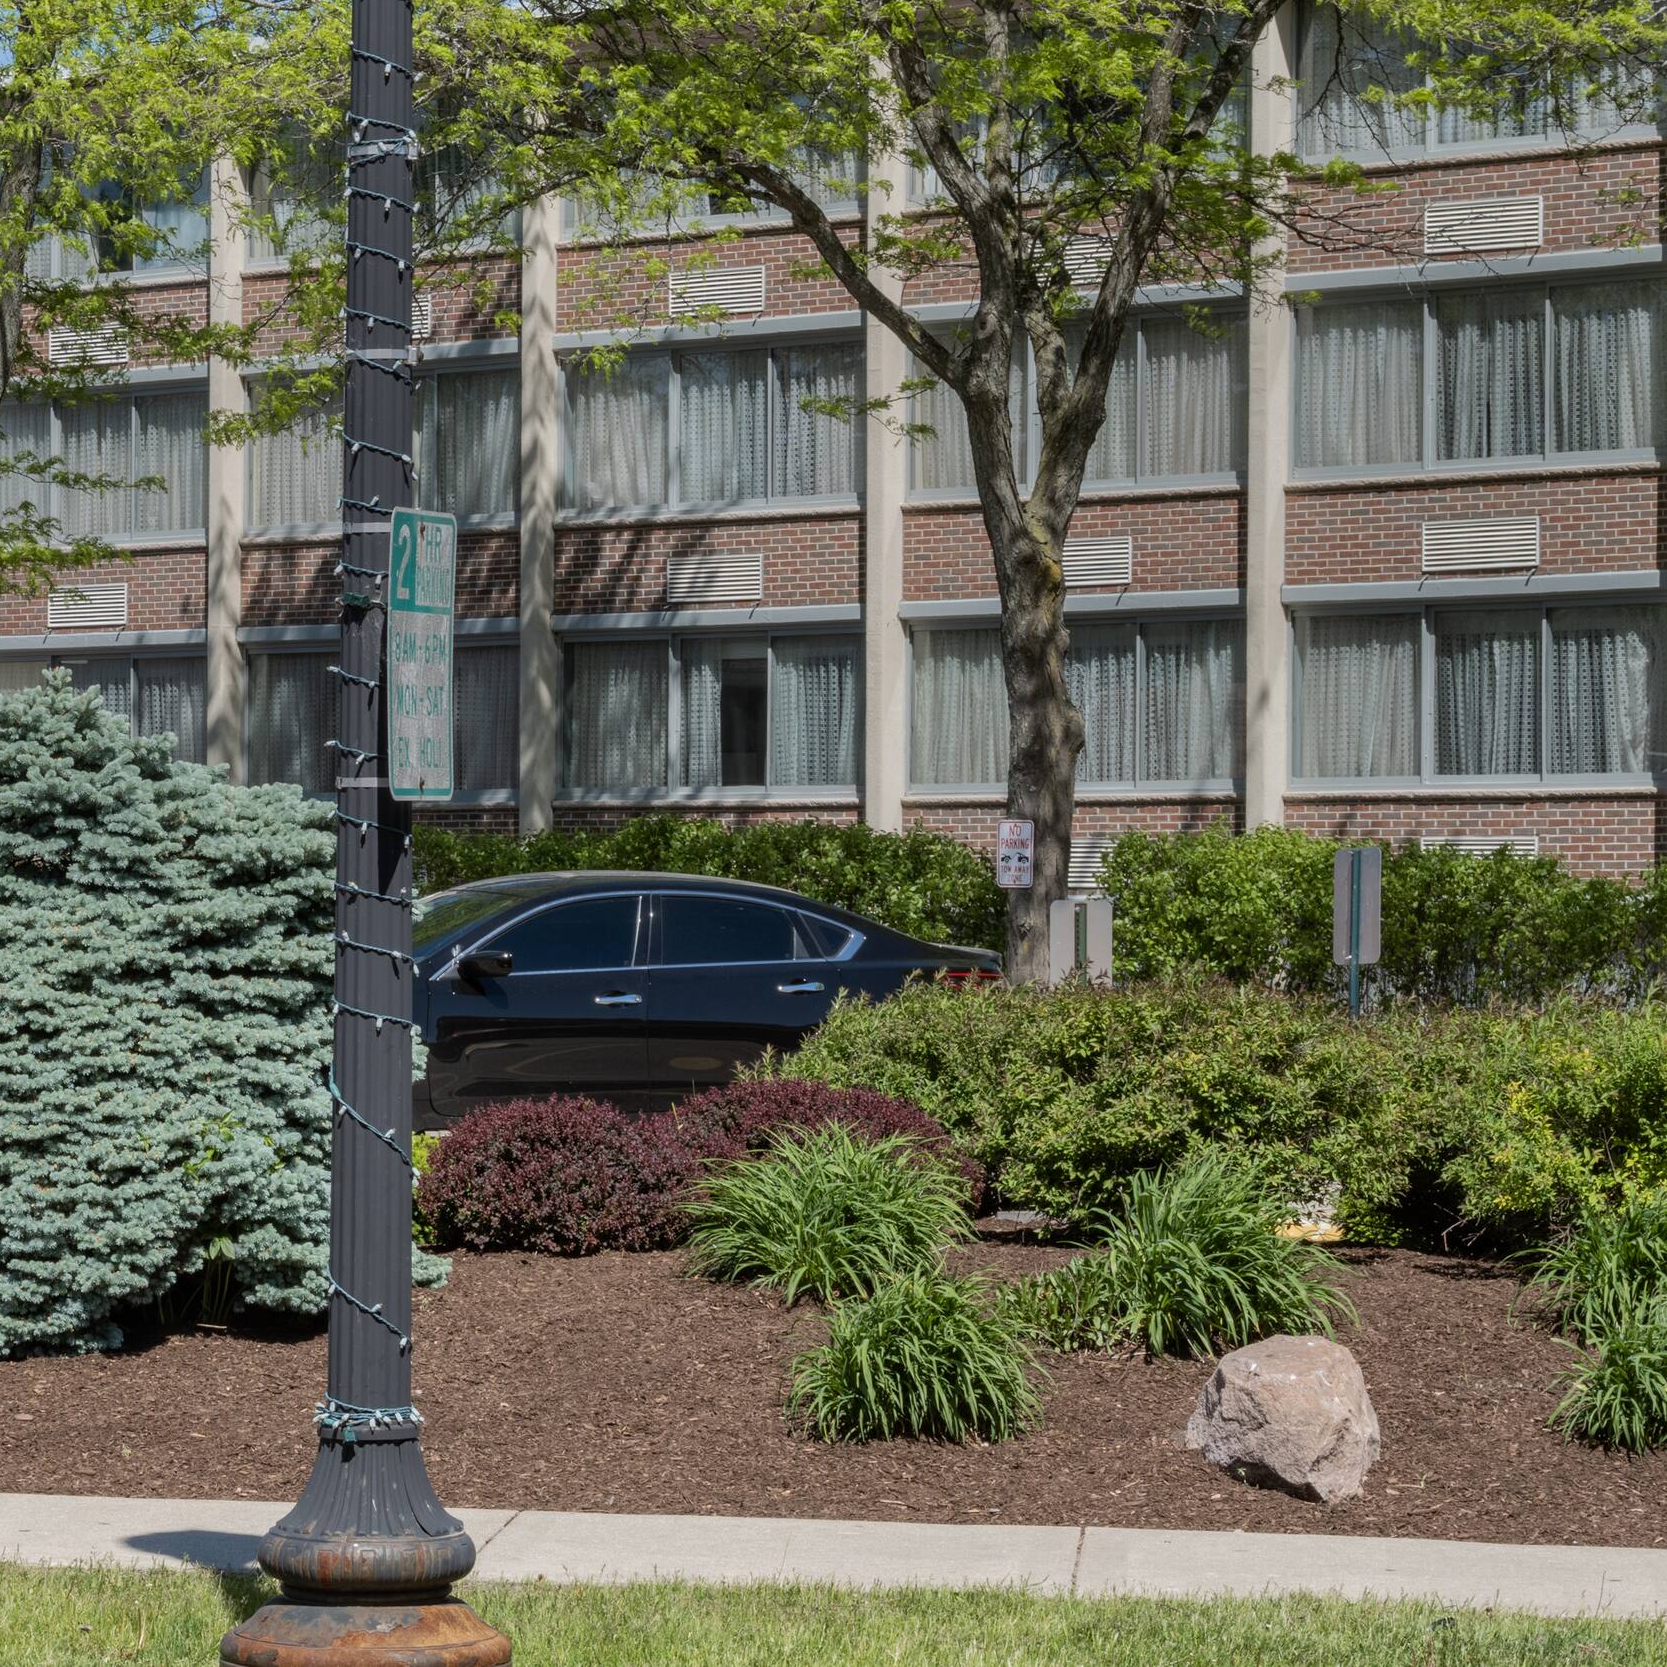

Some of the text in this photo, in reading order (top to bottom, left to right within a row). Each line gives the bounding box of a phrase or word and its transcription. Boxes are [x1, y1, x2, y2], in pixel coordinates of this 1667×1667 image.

[426, 525, 443, 564] HR
[397, 524, 411, 599] 2
[1001, 837, 1030, 849] PARKING
[1009, 825, 1022, 837] NO
